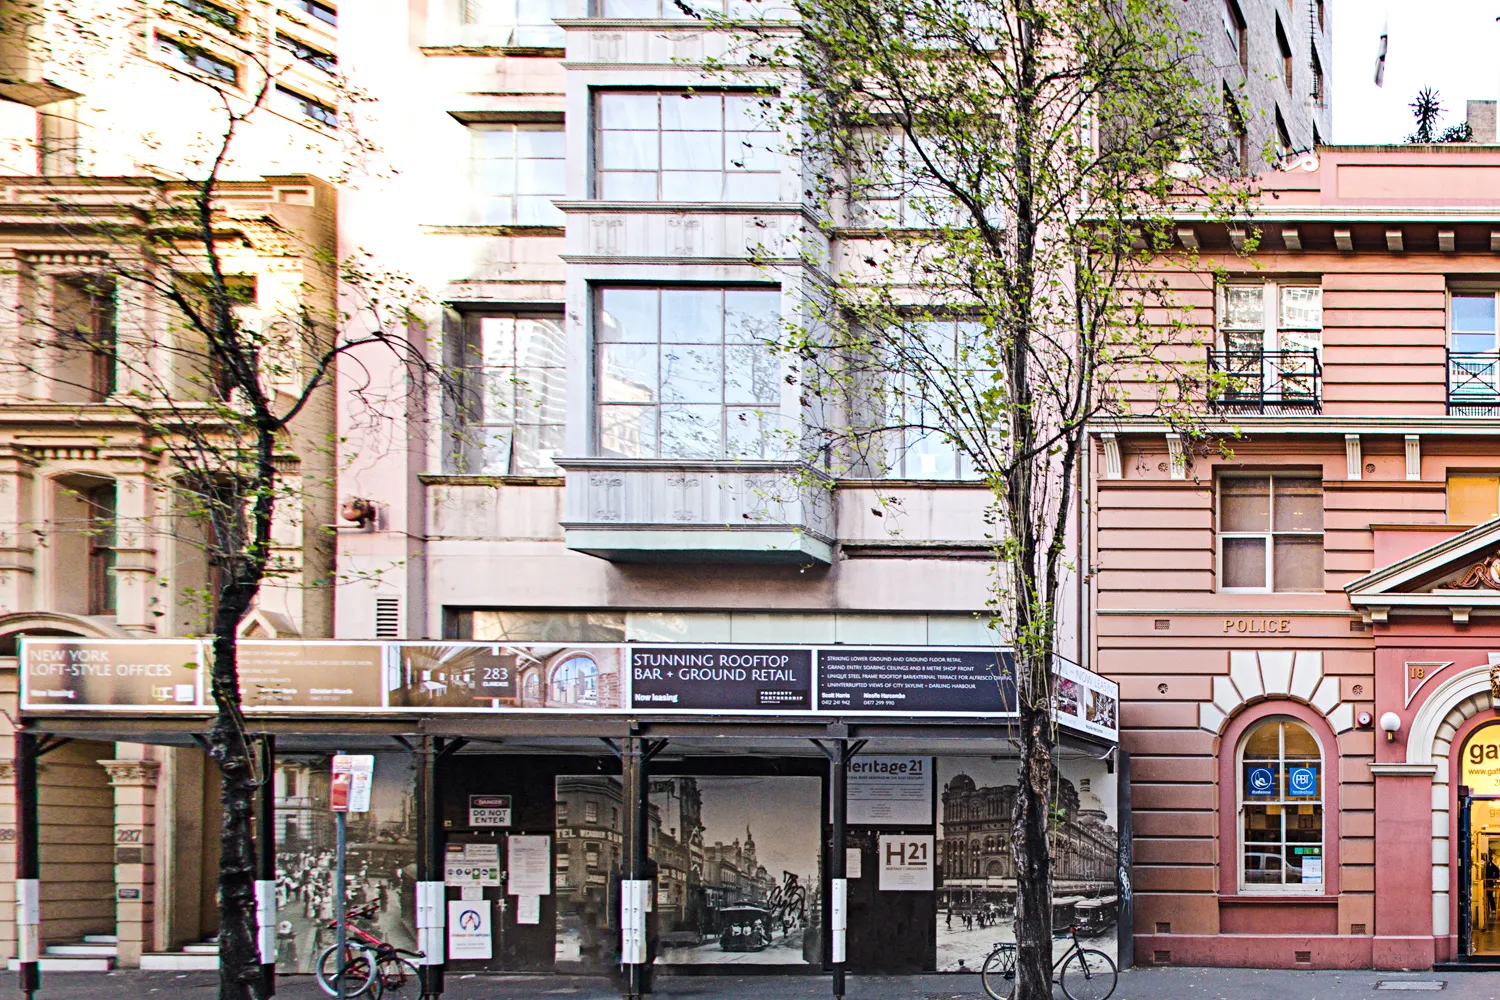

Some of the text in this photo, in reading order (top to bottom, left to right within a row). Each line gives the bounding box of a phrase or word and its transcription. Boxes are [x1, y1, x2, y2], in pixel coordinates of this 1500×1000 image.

[1223, 619, 1290, 633] POLICE
[30, 650, 110, 662] NEW YORK
[634, 654, 789, 667] STUNNING ROOFTOP
[30, 663, 172, 677] LOFT-STYLE OFFICES
[483, 667, 509, 680] 283
[634, 669, 663, 680] BAR
[679, 668, 746, 681] GROUND
[752, 669, 797, 681] RETAIL
[1410, 668, 1425, 679] 18
[634, 693, 678, 703] Now leasing
[909, 760, 923, 771] 21
[117, 829, 143, 842] 287
[886, 842, 927, 866] H21
